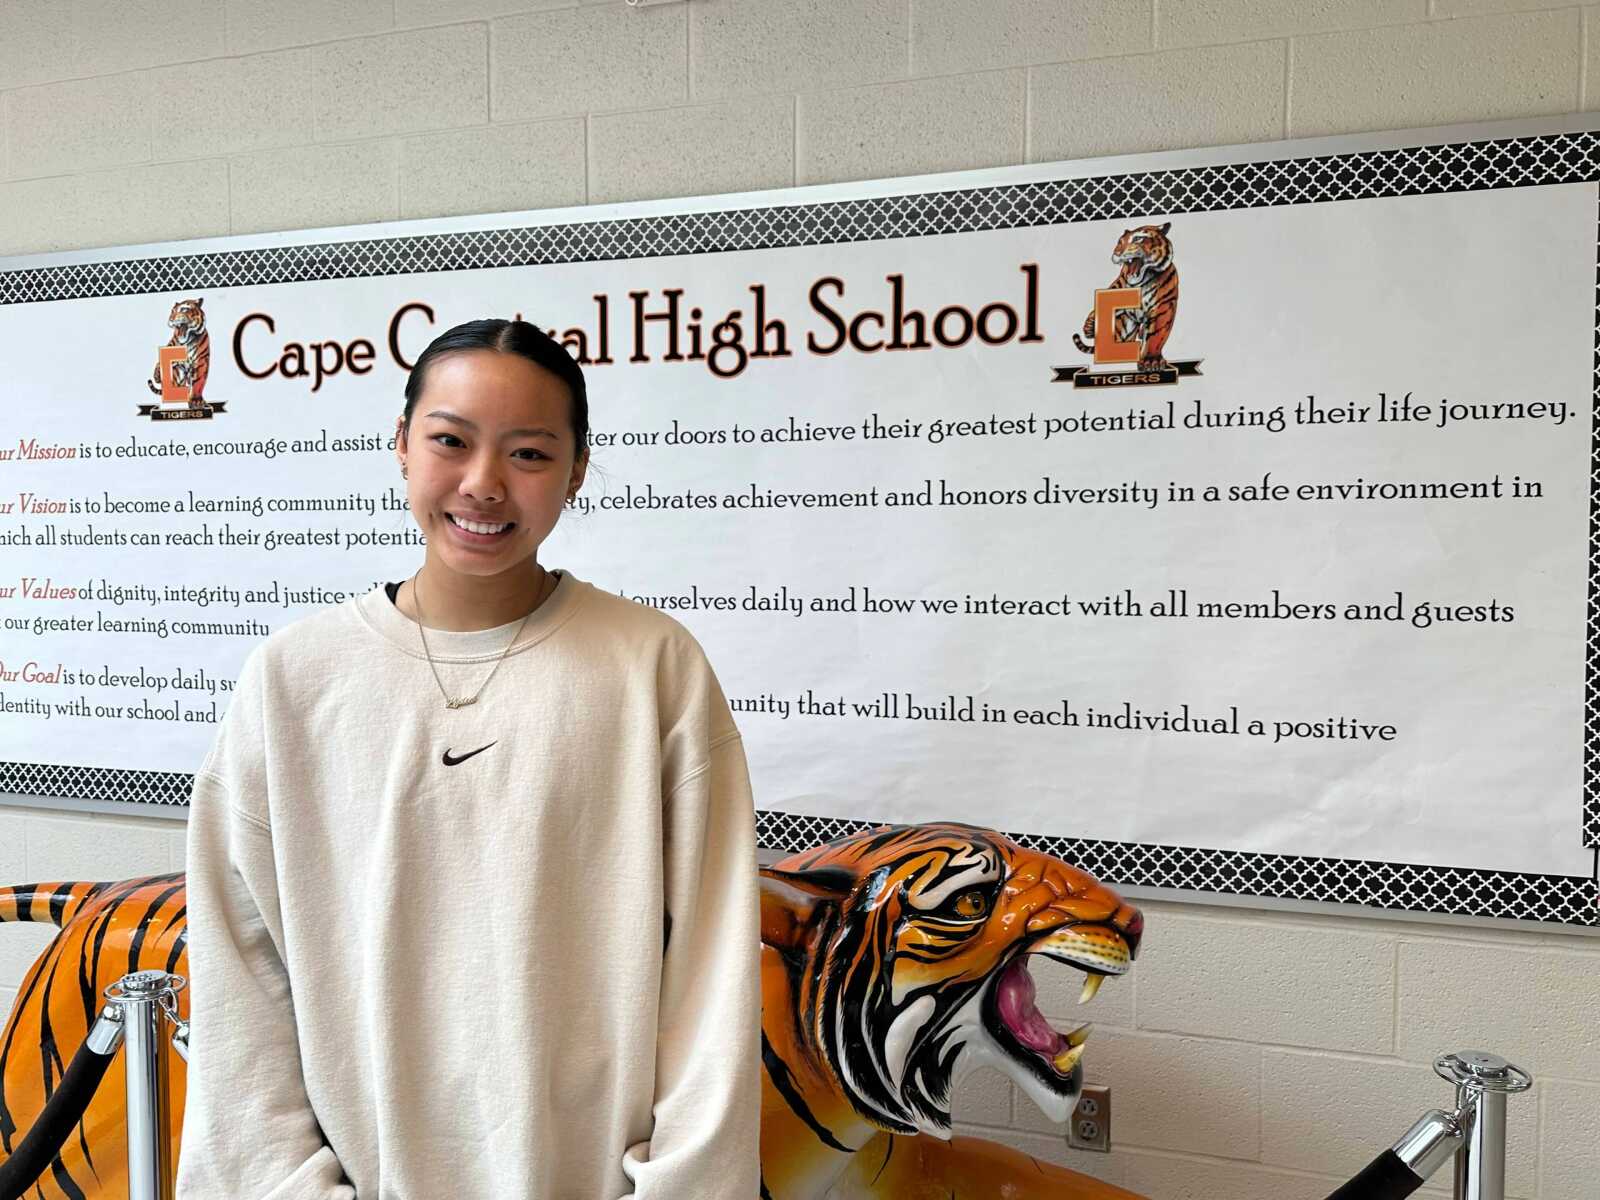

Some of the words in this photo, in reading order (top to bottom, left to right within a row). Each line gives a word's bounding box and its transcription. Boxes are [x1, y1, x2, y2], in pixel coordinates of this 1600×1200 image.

[232, 313, 376, 393] Cape
[628, 284, 793, 379] High
[807, 263, 1045, 356] School
[1090, 373, 1161, 385] TIGERS
[0, 449, 15, 460] ur
[16, 439, 76, 460] Mission
[80, 443, 91, 459] is
[95, 442, 112, 458] to
[115, 436, 189, 458] educate,
[193, 438, 287, 459] encourage
[291, 429, 327, 453] and
[332, 432, 382, 452] assist
[587, 427, 617, 447] ter
[622, 432, 659, 446] our
[664, 420, 726, 445] doors
[732, 424, 755, 443] to
[760, 417, 856, 443] achieve
[862, 413, 922, 439] their
[928, 412, 1037, 443] greatest
[1044, 401, 1176, 439] potential
[1184, 400, 1286, 432] during
[1294, 395, 1371, 424] their
[1377, 392, 1432, 422] life
[1436, 399, 1575, 428] journey.
[160, 411, 203, 419] TIGERS
[0, 502, 14, 514] ur
[19, 493, 67, 514] Vision
[70, 498, 81, 513] is
[85, 497, 100, 513] to
[104, 492, 170, 513] become
[174, 501, 185, 512] a
[188, 490, 263, 517] learning
[267, 493, 375, 516] community
[600, 484, 717, 509] celebrates
[722, 483, 879, 508] achievement
[885, 480, 933, 507] and
[939, 480, 1027, 505] honors
[1033, 477, 1158, 509] diversity
[1168, 482, 1195, 502] in
[1203, 486, 1221, 502] a
[1228, 472, 1290, 501] safe
[1297, 475, 1503, 500] environment
[1512, 476, 1543, 497] in
[35, 525, 56, 545] all
[60, 524, 127, 545] students
[130, 533, 160, 545] can
[165, 523, 214, 545] reach
[218, 523, 260, 545] their
[264, 528, 340, 551] greatest
[345, 528, 427, 550] potentia
[0, 587, 16, 598] ur
[22, 578, 77, 599] Values
[78, 579, 94, 600] of
[96, 579, 160, 606] dignity,
[164, 585, 240, 607] integrity
[245, 581, 280, 603] and
[283, 586, 345, 608] justice
[742, 586, 802, 617] daily
[810, 587, 857, 612] and
[862, 587, 916, 613] how
[920, 600, 958, 614] we
[964, 594, 1071, 616] interact
[1077, 589, 1143, 616] with
[1150, 590, 1188, 617] all
[1197, 590, 1336, 620] members
[1344, 592, 1405, 621] and
[1411, 599, 1514, 628] guests
[5, 618, 30, 630] our
[33, 615, 94, 635] greater
[97, 611, 168, 638] learning
[0, 661, 20, 681] ur
[23, 662, 62, 684] Goal
[63, 669, 75, 685] is
[79, 669, 95, 685] to
[98, 665, 168, 693] develop
[171, 667, 216, 696] daily
[0, 691, 50, 720] dentity
[54, 696, 92, 717] with
[95, 706, 123, 718] our
[127, 698, 180, 721] school
[184, 701, 217, 723] and
[797, 689, 846, 716] that
[852, 693, 899, 718] will
[905, 693, 976, 722] build
[982, 704, 1007, 722] in
[1013, 700, 1080, 726] each
[1086, 702, 1240, 734] individual
[1248, 720, 1266, 735] a
[1273, 716, 1397, 743] positive
